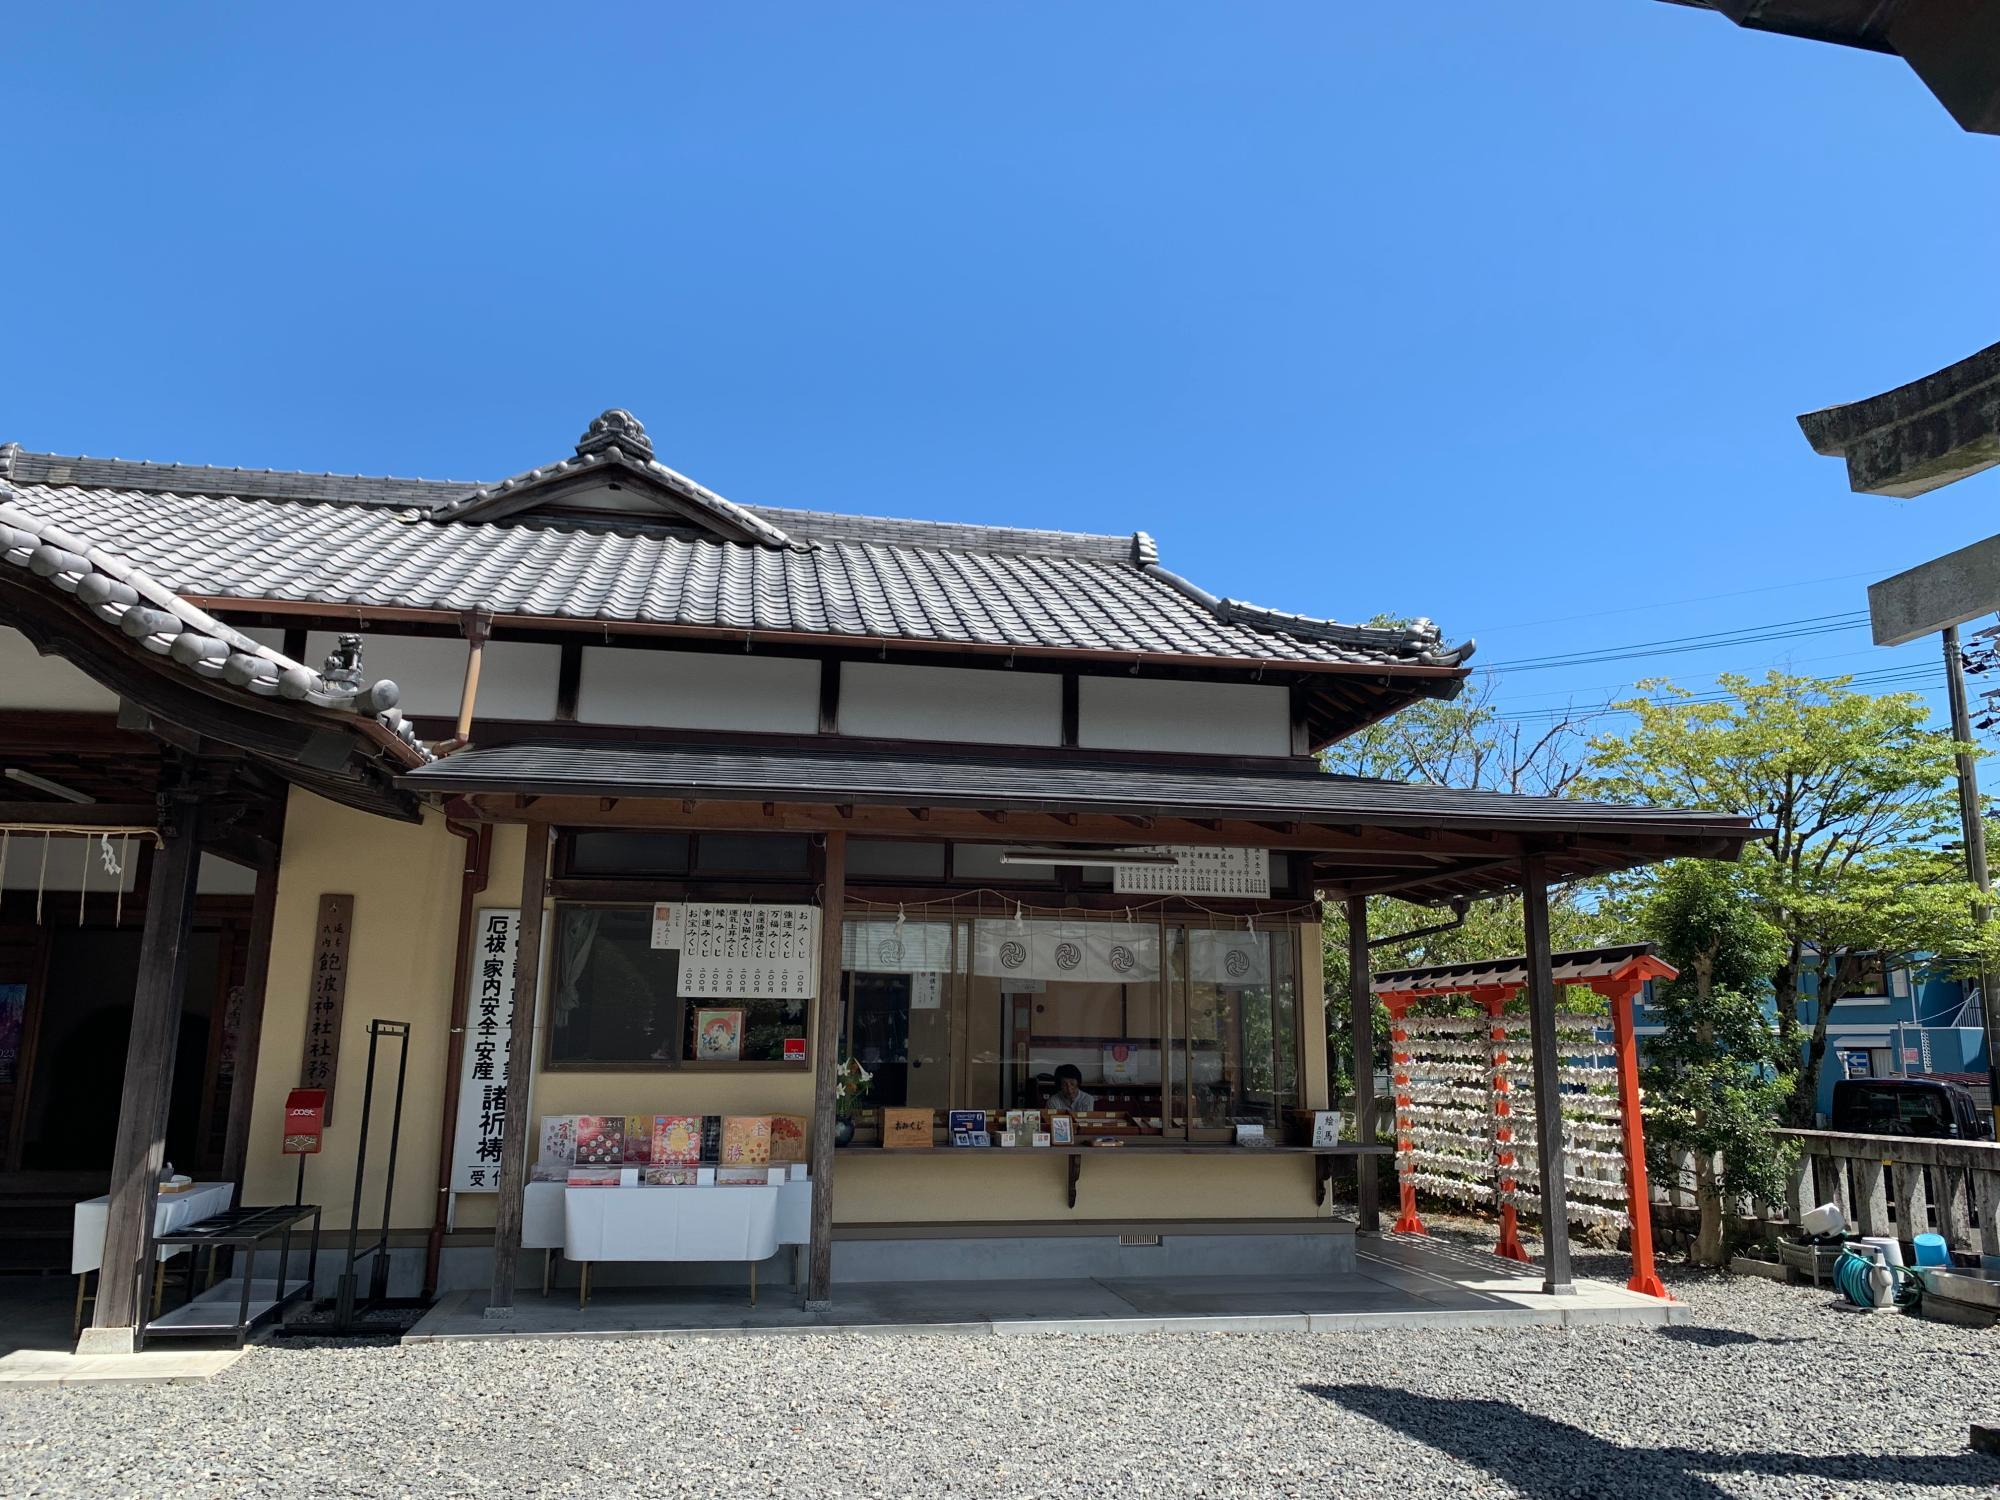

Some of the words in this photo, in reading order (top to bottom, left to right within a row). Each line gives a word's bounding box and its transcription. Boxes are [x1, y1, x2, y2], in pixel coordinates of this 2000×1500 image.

[687, 909, 698, 957] お宝みくじ
[701, 910, 712, 958] 幸運みくじ
[714, 909, 725, 957] 縁みくじ
[727, 910, 738, 958] 運気上昇みくじ
[768, 910, 780, 959] 万福みくじ
[782, 910, 793, 959] 強運みくじ
[798, 911, 809, 958] おみくじ
[685, 968, 693, 992] 二〇〇円
[753, 969, 761, 992] 二〇〇円
[306, 952, 343, 1089] 飽波神社社務
[895, 1120, 926, 1131] おみくじ
[1324, 1115, 1334, 1142] 絵馬
